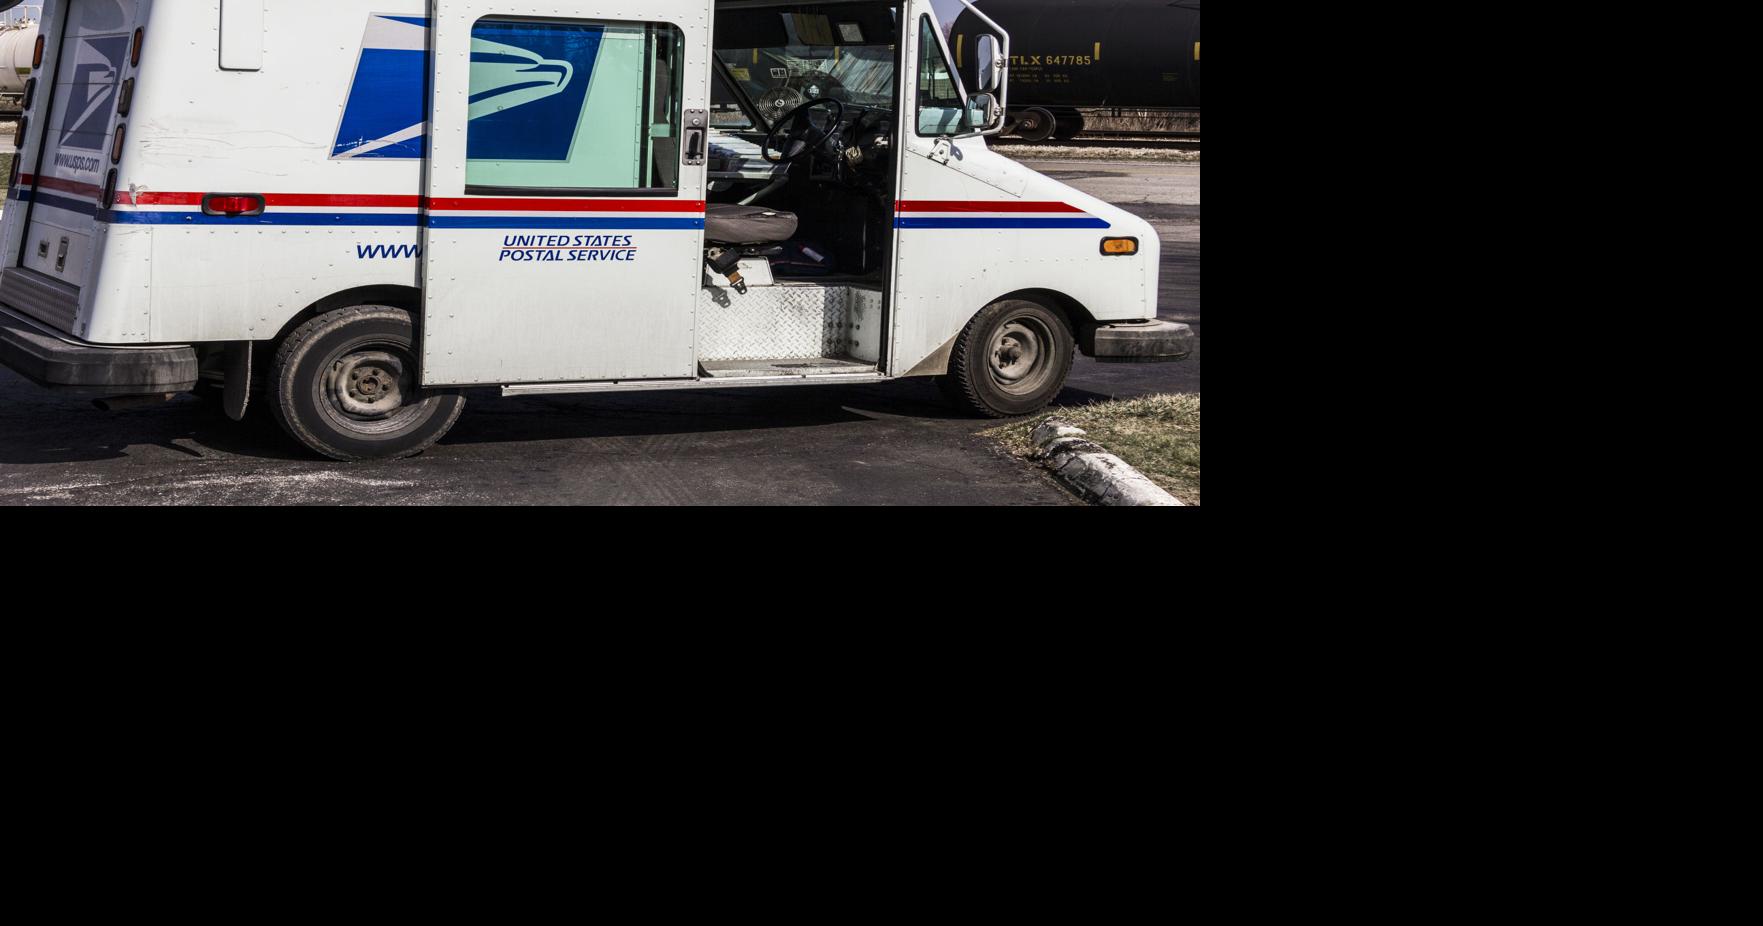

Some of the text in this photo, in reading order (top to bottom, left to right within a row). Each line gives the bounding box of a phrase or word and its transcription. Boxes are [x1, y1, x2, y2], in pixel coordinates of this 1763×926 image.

[1046, 55, 1091, 65] 647785
[54, 153, 100, 174] www.usps.com
[503, 235, 633, 247] UNITED STATES
[498, 249, 637, 261] POSTAL SERVICE
